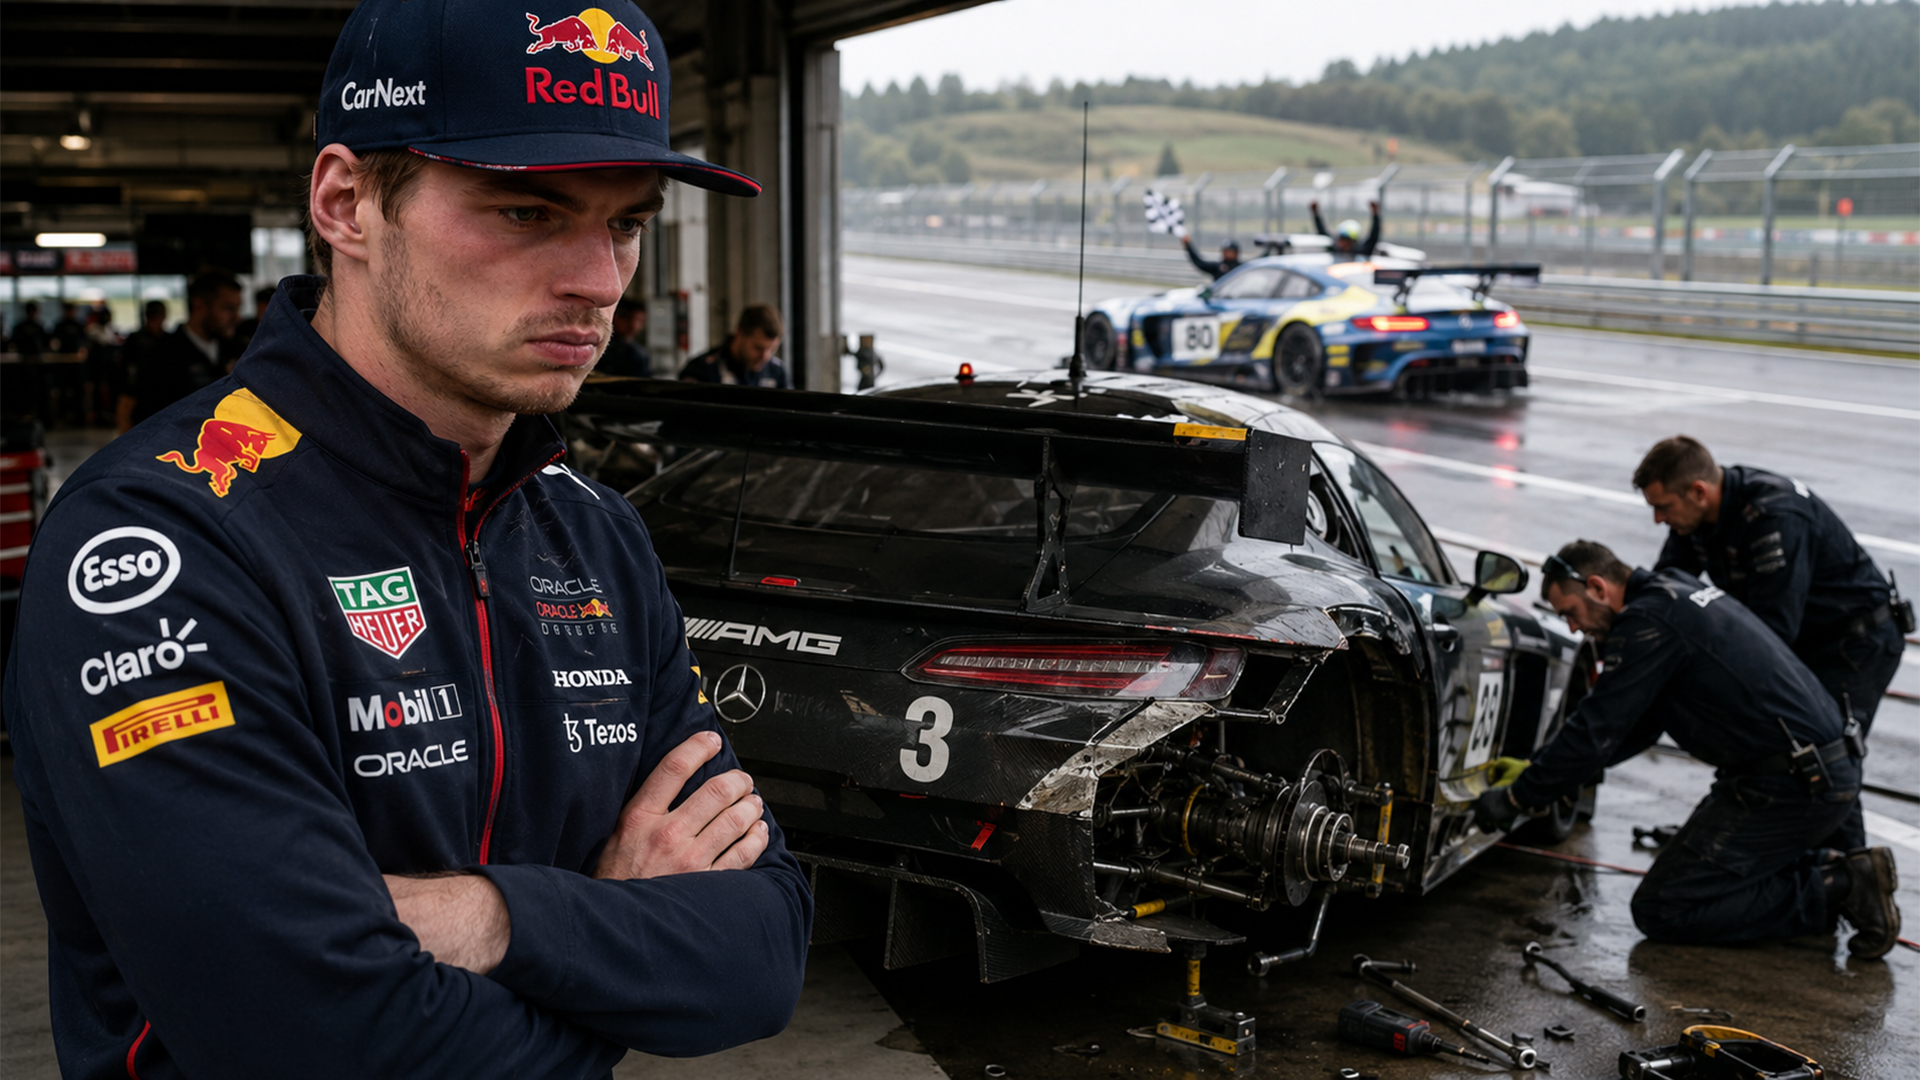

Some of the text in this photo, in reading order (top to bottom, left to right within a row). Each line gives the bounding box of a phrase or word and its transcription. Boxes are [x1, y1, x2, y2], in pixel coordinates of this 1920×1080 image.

[341, 78, 426, 111] CarNext
[525, 67, 660, 120] Red Bull
[1186, 324, 1213, 350] 80
[335, 575, 410, 607] TAG
[529, 575, 603, 596] ORACLE
[348, 608, 421, 653] HEUER
[708, 621, 843, 656] AMG
[80, 640, 185, 695] Claro
[552, 669, 632, 687] HONDA
[102, 693, 220, 755] PIRELLI
[348, 688, 434, 732] Mobil
[584, 718, 638, 745] Tezos
[900, 695, 954, 783] 3
[354, 739, 469, 777] ORACLE
